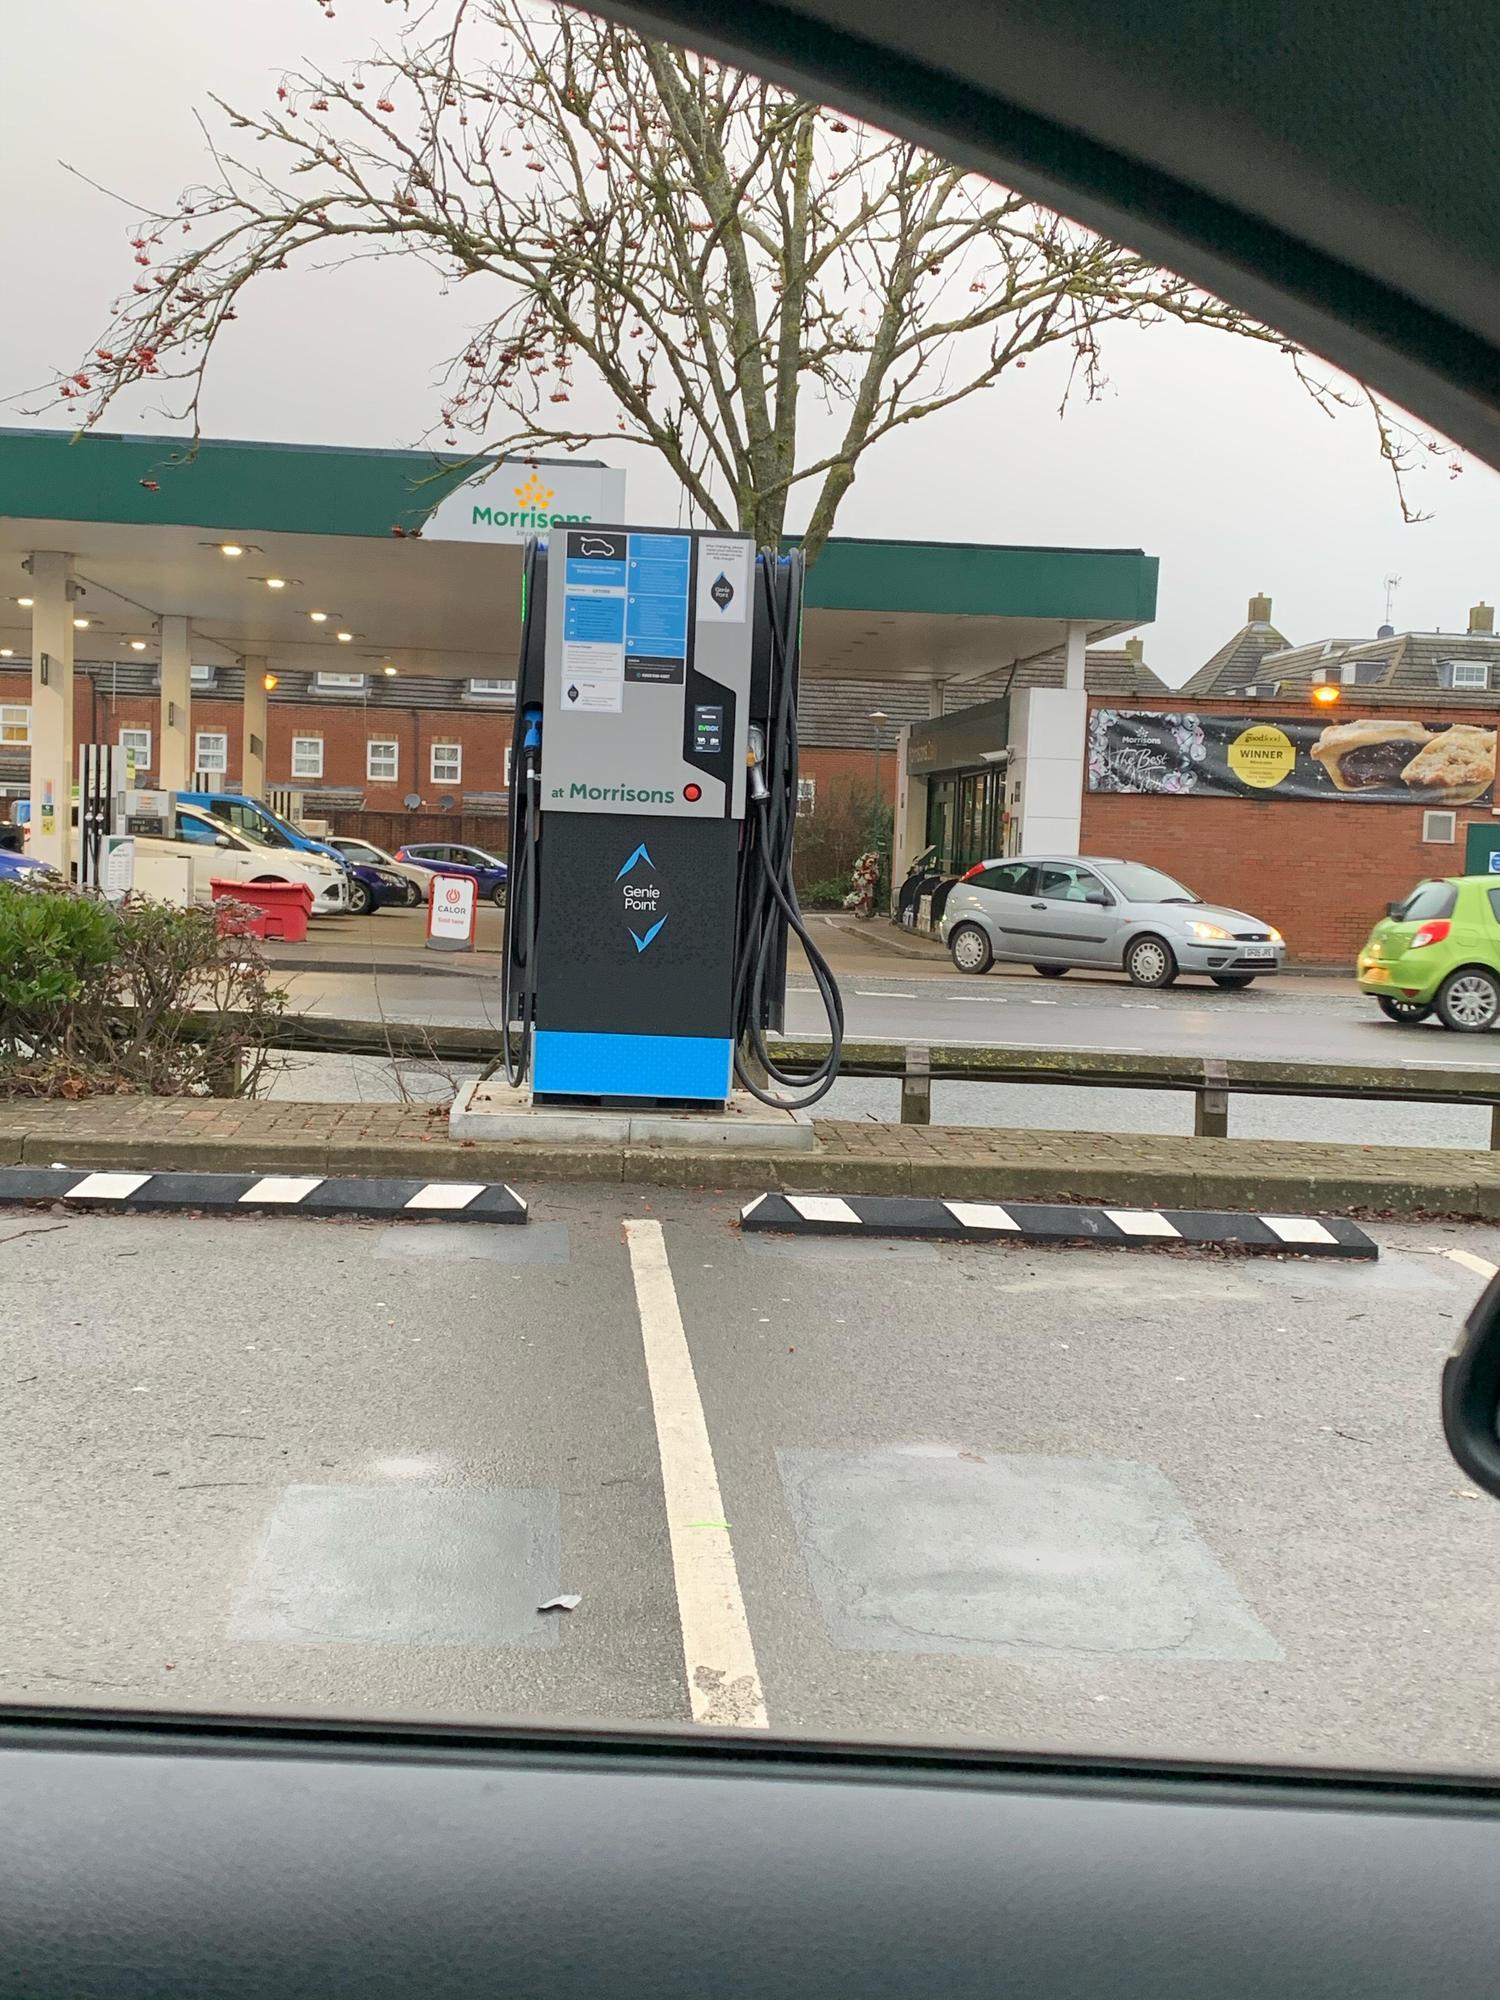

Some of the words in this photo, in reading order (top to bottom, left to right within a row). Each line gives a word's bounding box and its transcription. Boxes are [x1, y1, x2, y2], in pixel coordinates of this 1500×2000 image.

[1122, 736, 1161, 745] Morrisons
[1110, 748, 1137, 769] The
[1136, 748, 1169, 770] Best
[1240, 750, 1283, 759] WINNER
[551, 788, 565, 798] at
[569, 783, 675, 804] Morrisons
[623, 884, 661, 898] Genie
[438, 905, 466, 914] CALOR
[624, 897, 657, 911] Point
